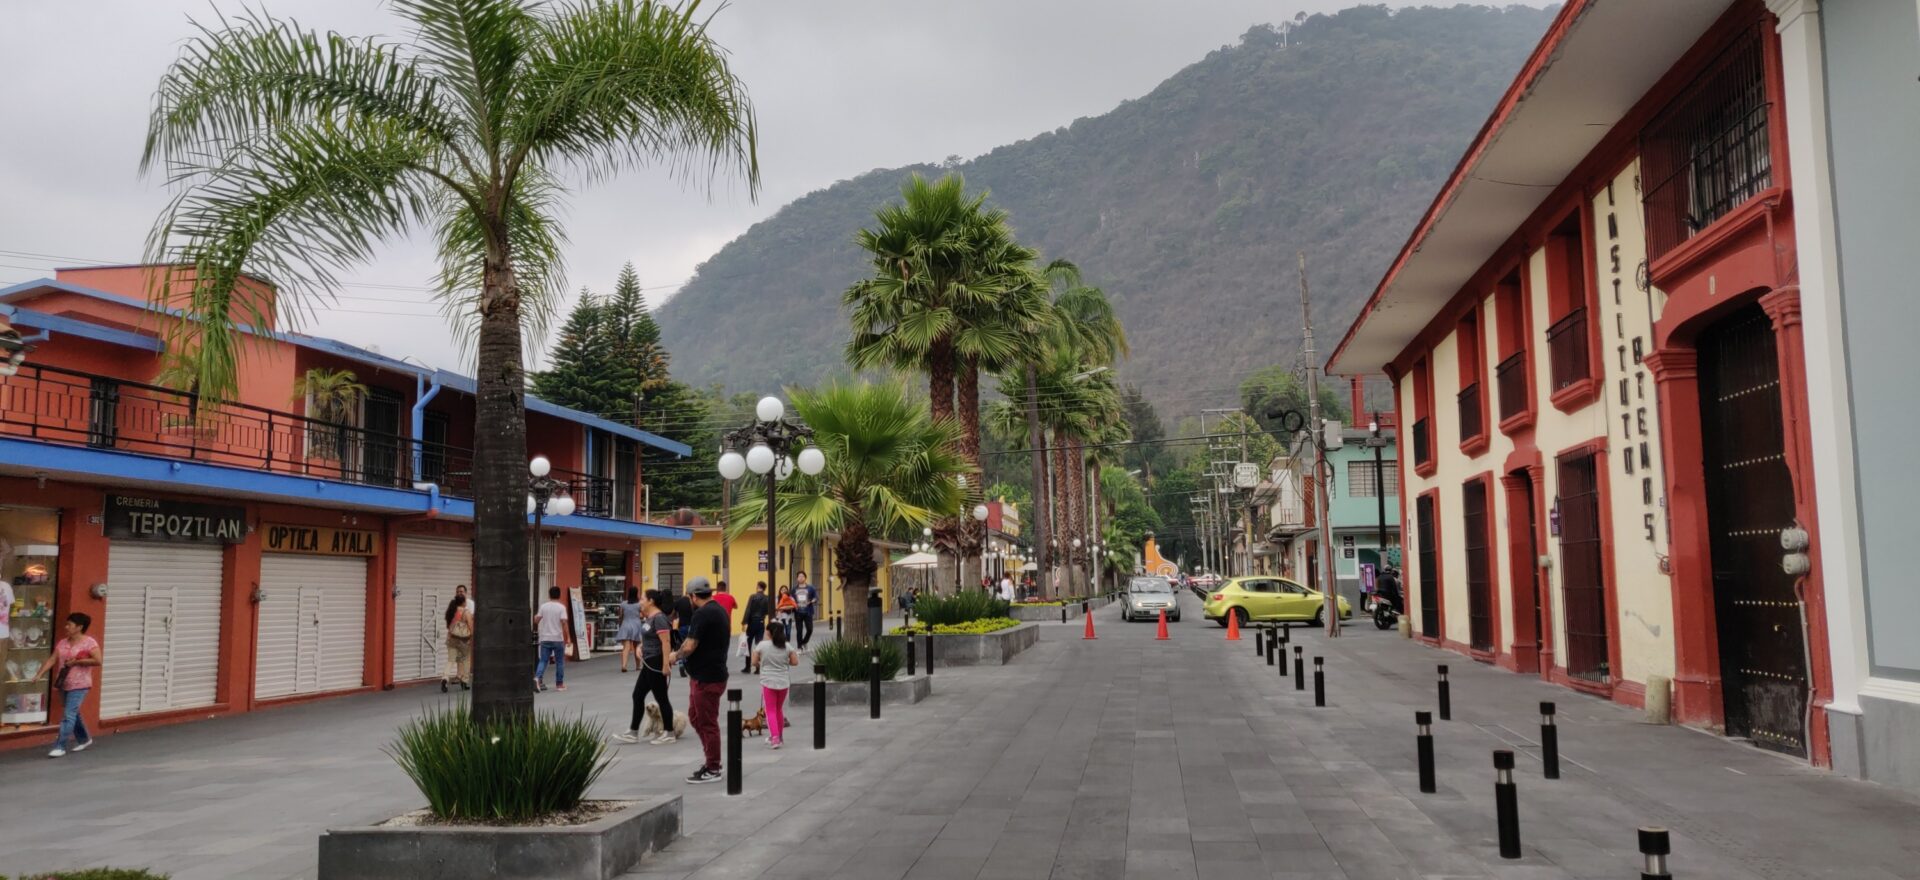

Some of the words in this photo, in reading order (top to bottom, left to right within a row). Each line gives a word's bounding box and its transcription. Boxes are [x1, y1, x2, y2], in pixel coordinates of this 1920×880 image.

[1607, 179, 1634, 475] INSTITUTO
[115, 496, 160, 509] CREMERIA
[128, 511, 240, 539] TEPOZTLAN
[268, 525, 319, 552] OPTICA
[331, 530, 373, 554] AYALA
